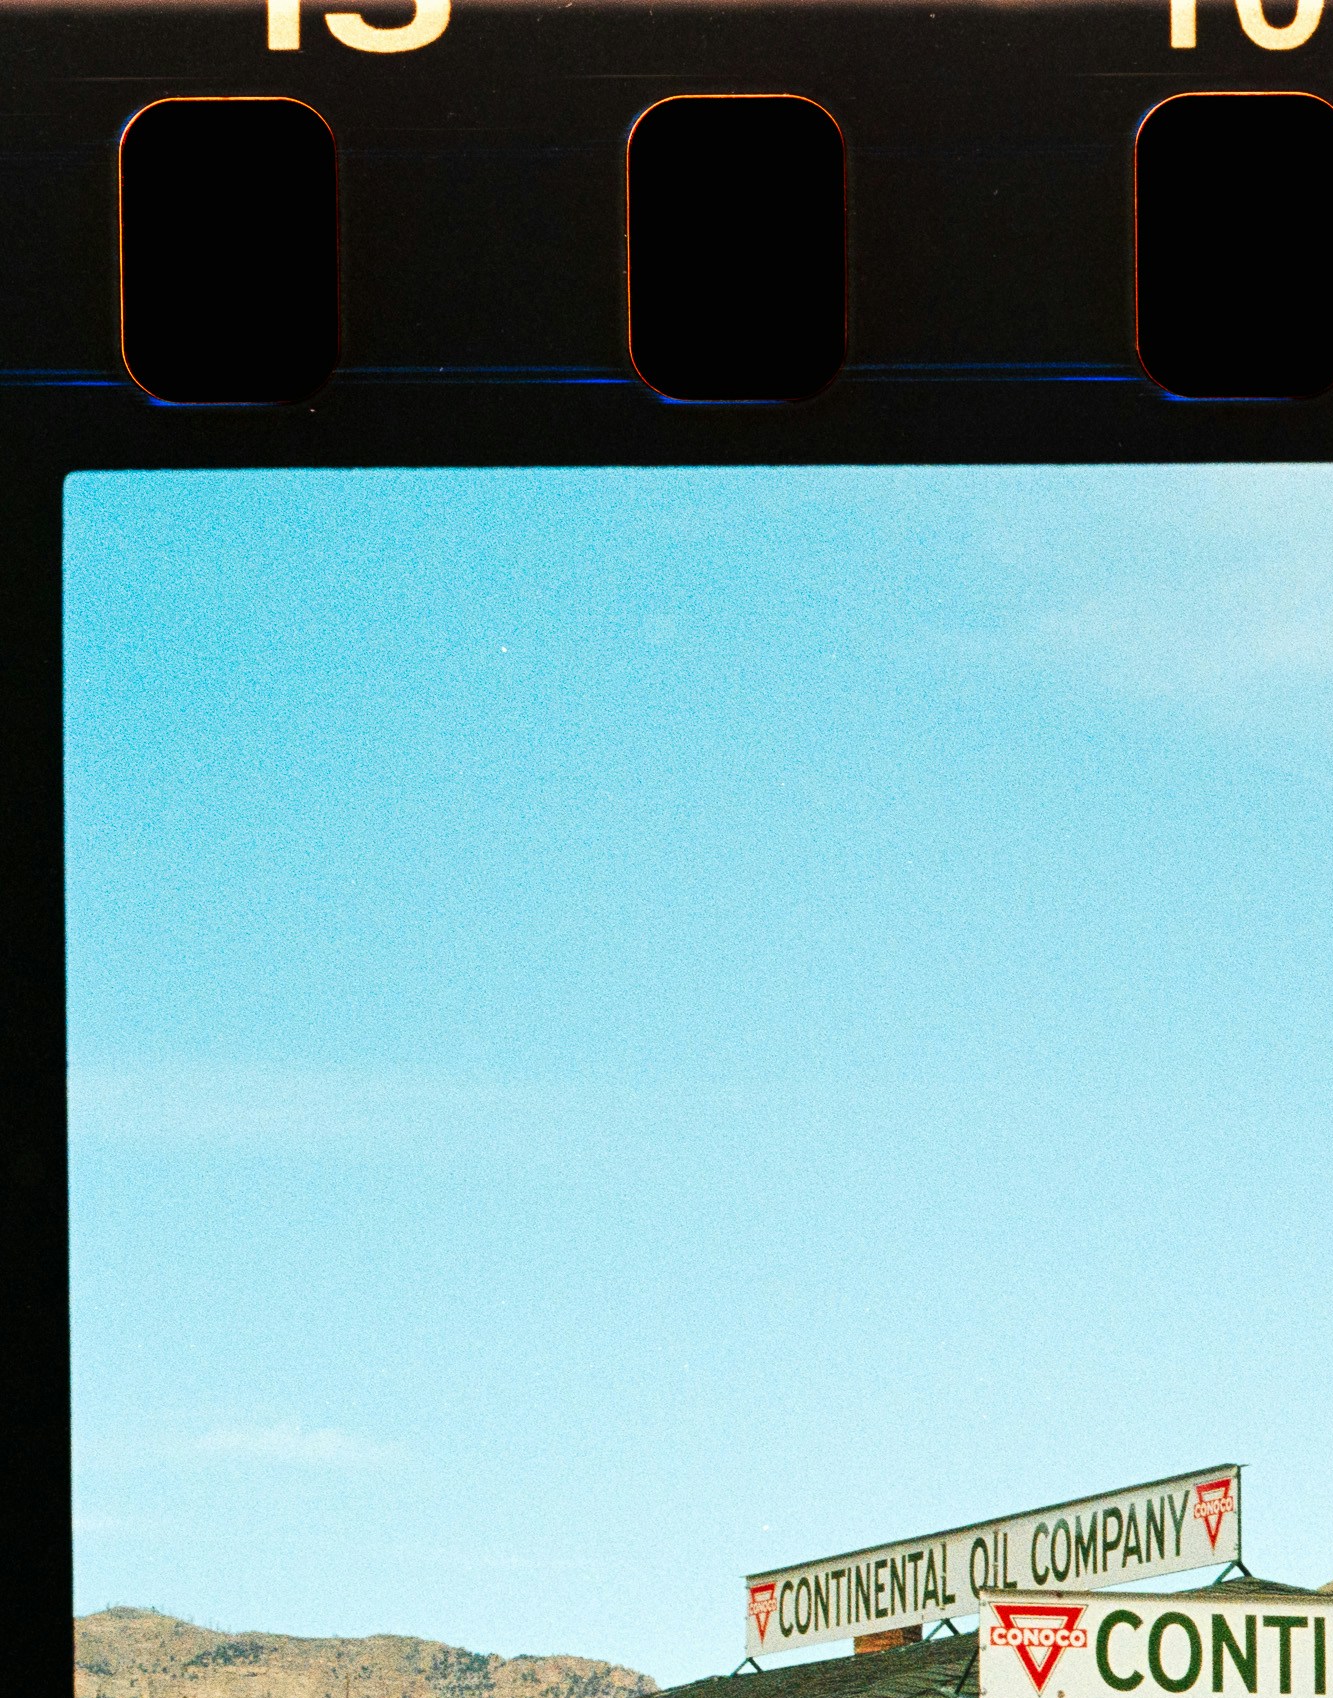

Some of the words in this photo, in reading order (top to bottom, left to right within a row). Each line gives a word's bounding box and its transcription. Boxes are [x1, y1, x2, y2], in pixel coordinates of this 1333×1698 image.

[1194, 1497, 1234, 1519] CONOCO
[778, 1541, 956, 1638] CONTINENTAL
[969, 1530, 1018, 1600] OIL
[1030, 1489, 1191, 1586] COMPANY
[991, 1626, 1087, 1649] CONOCO
